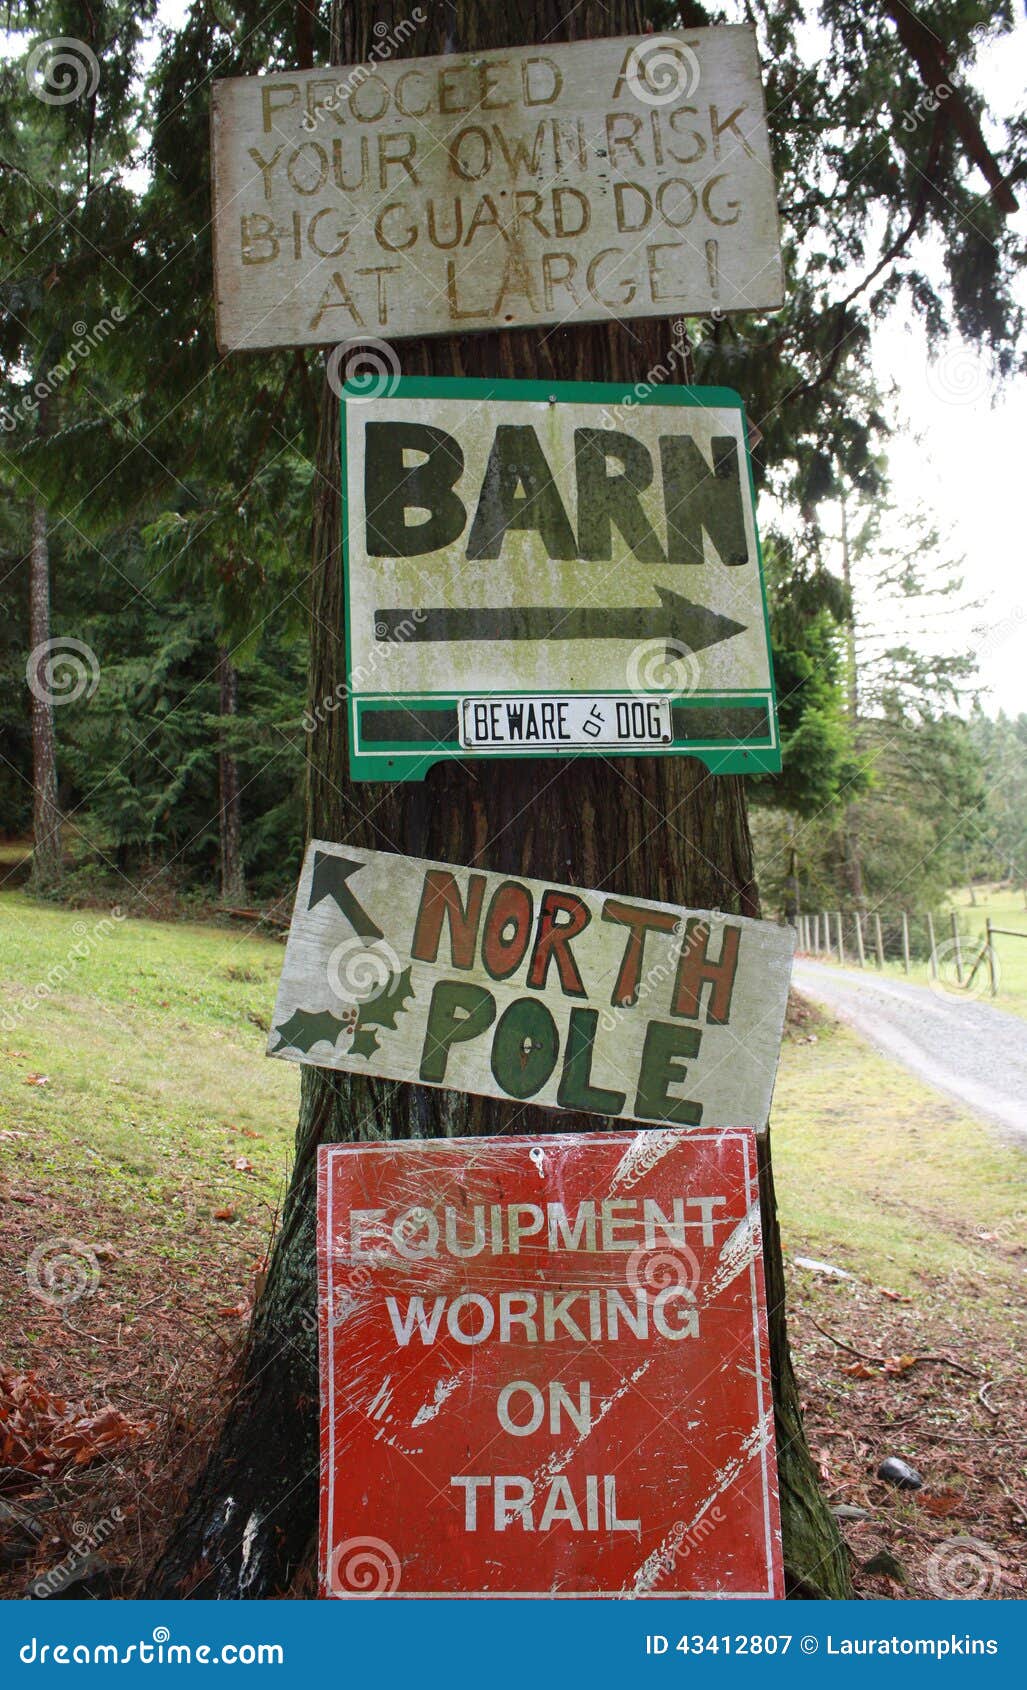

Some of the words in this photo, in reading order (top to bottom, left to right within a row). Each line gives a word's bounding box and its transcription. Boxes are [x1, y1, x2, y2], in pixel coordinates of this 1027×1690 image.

[261, 57, 564, 134] PROCEED
[248, 132, 420, 200] YOUR
[448, 118, 588, 183] OWN
[606, 103, 756, 169] RISK
[240, 207, 350, 266] BIG
[374, 187, 591, 251] GUARD
[613, 173, 741, 233] DOG
[308, 265, 402, 332] AT
[365, 421, 749, 566] BARN
[474, 702, 571, 741] BEWARE
[582, 703, 606, 738] OF
[616, 702, 661, 739] DOG
[410, 869, 741, 1025] NORTH
[419, 979, 703, 1125] POLE
[350, 1196, 727, 1263] EQUIPMENT
[385, 1285, 701, 1346] WORKING
[497, 1380, 592, 1436] ON
[451, 1473, 642, 1534] TRAIL
